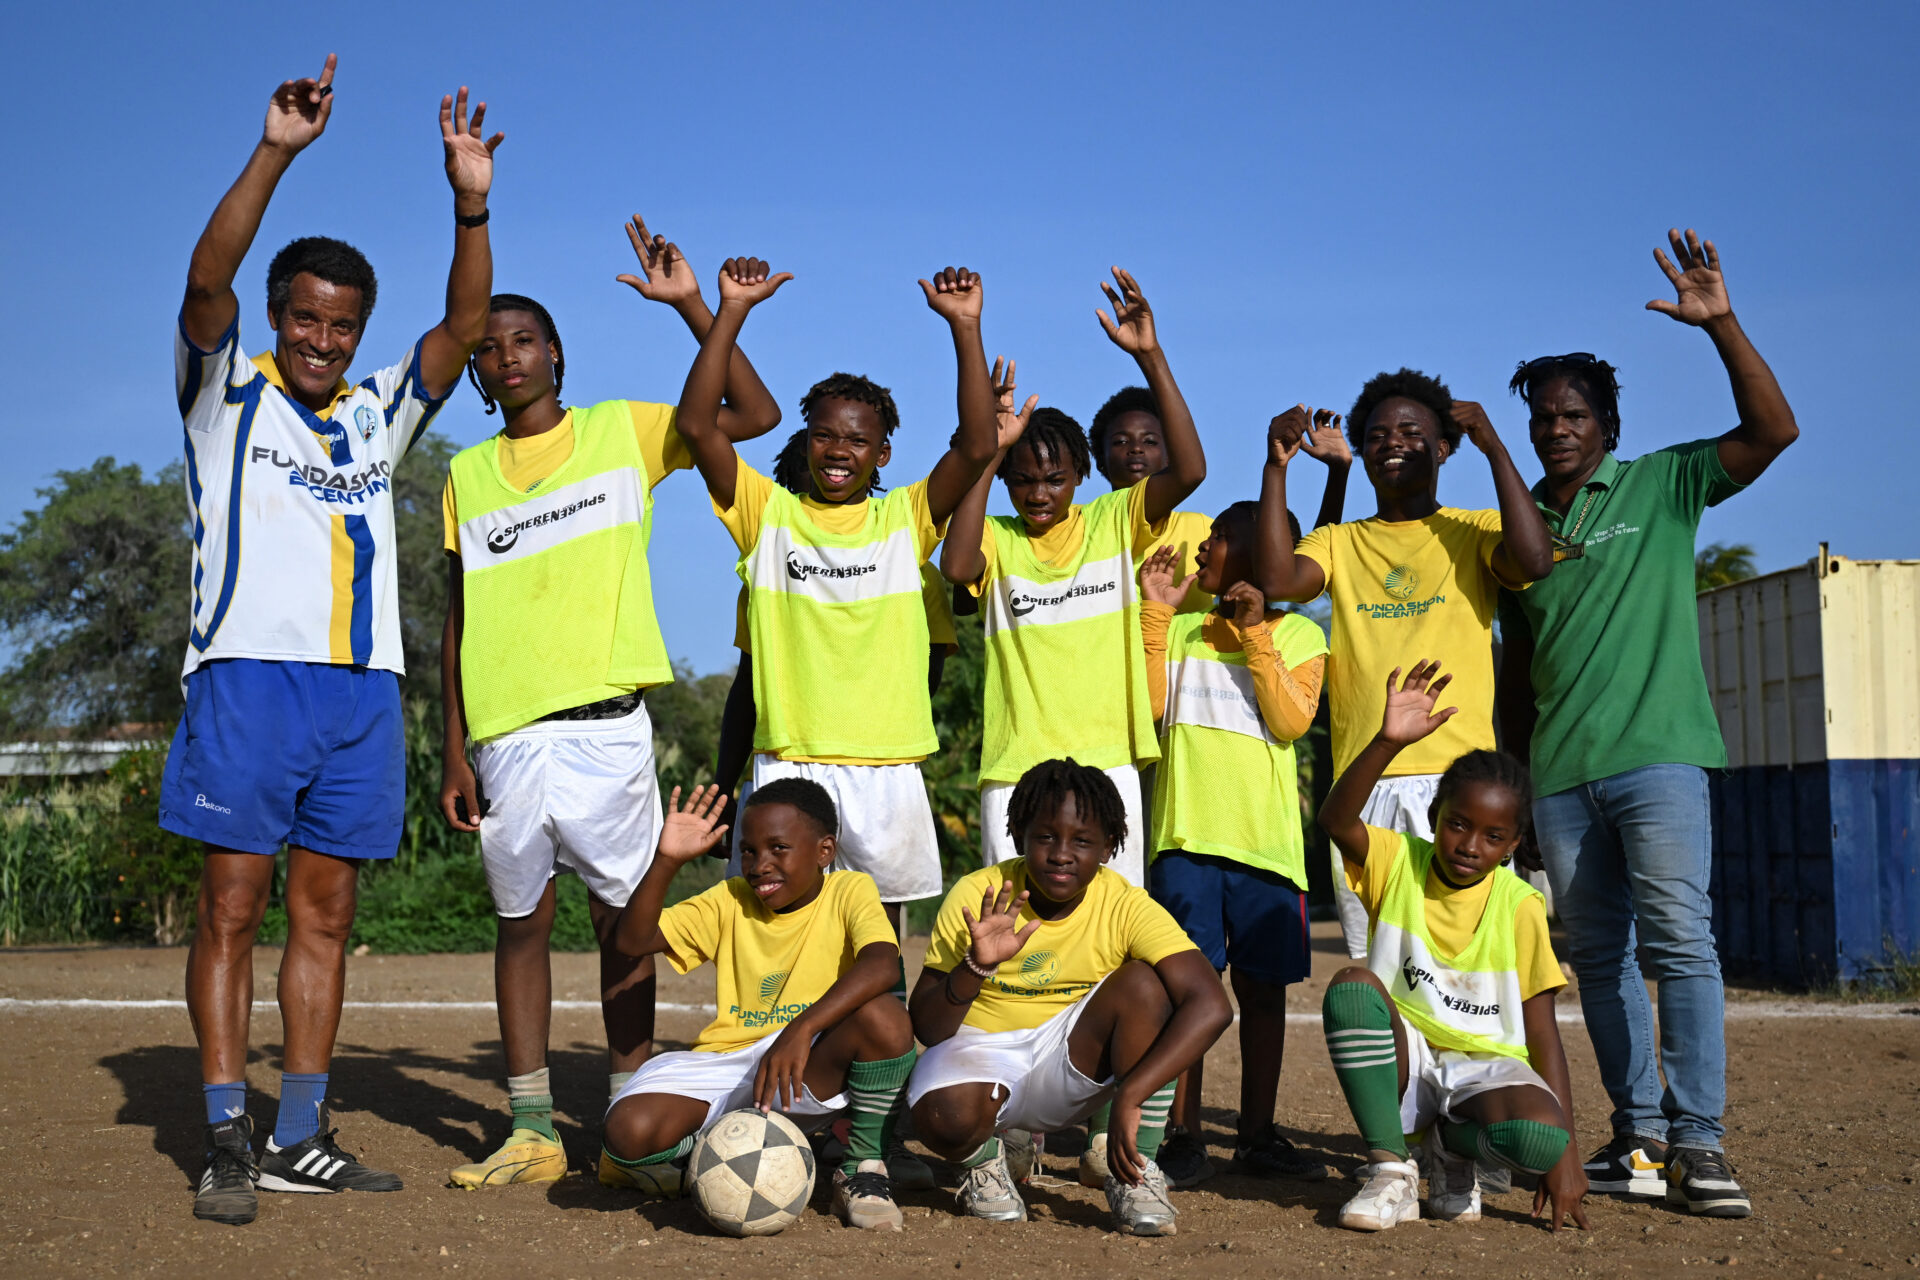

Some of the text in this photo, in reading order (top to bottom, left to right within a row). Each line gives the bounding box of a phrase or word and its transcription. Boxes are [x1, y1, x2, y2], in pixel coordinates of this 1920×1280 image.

[251, 445, 391, 492] FUNDASHO
[1356, 595, 1446, 613] FUNDASHON
[1371, 607, 1429, 618] BICENTINI
